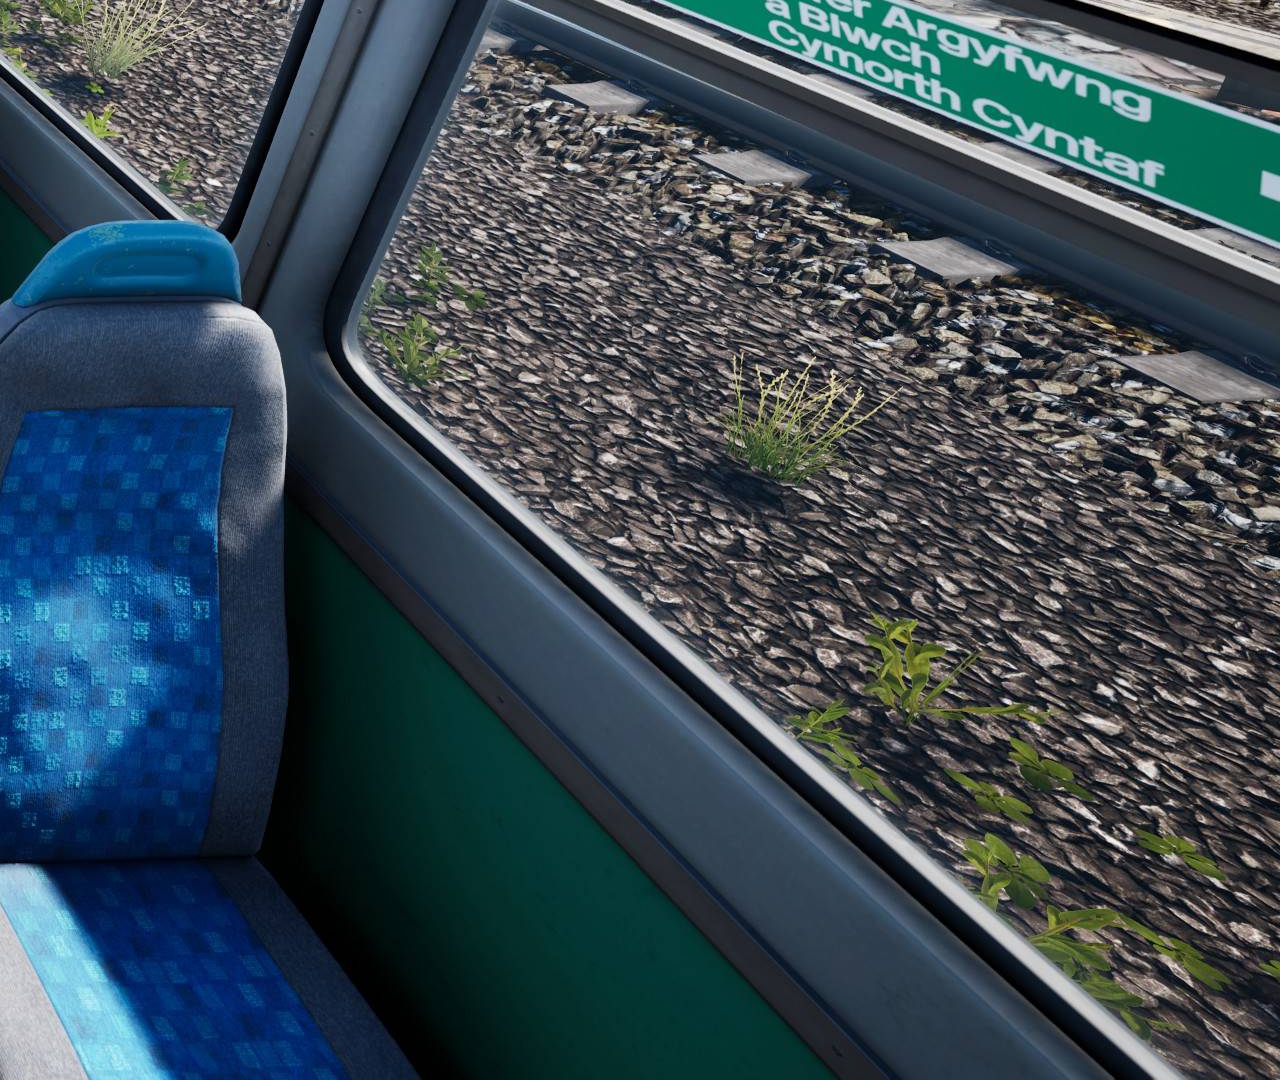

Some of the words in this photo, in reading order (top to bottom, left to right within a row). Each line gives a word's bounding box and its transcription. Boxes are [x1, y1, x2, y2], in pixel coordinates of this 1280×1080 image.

[799, 1, 941, 75] Blwch
[881, 6, 1152, 122] Argyfwng
[768, 19, 961, 112] Cymorth
[972, 96, 1165, 188] Cyntaf
